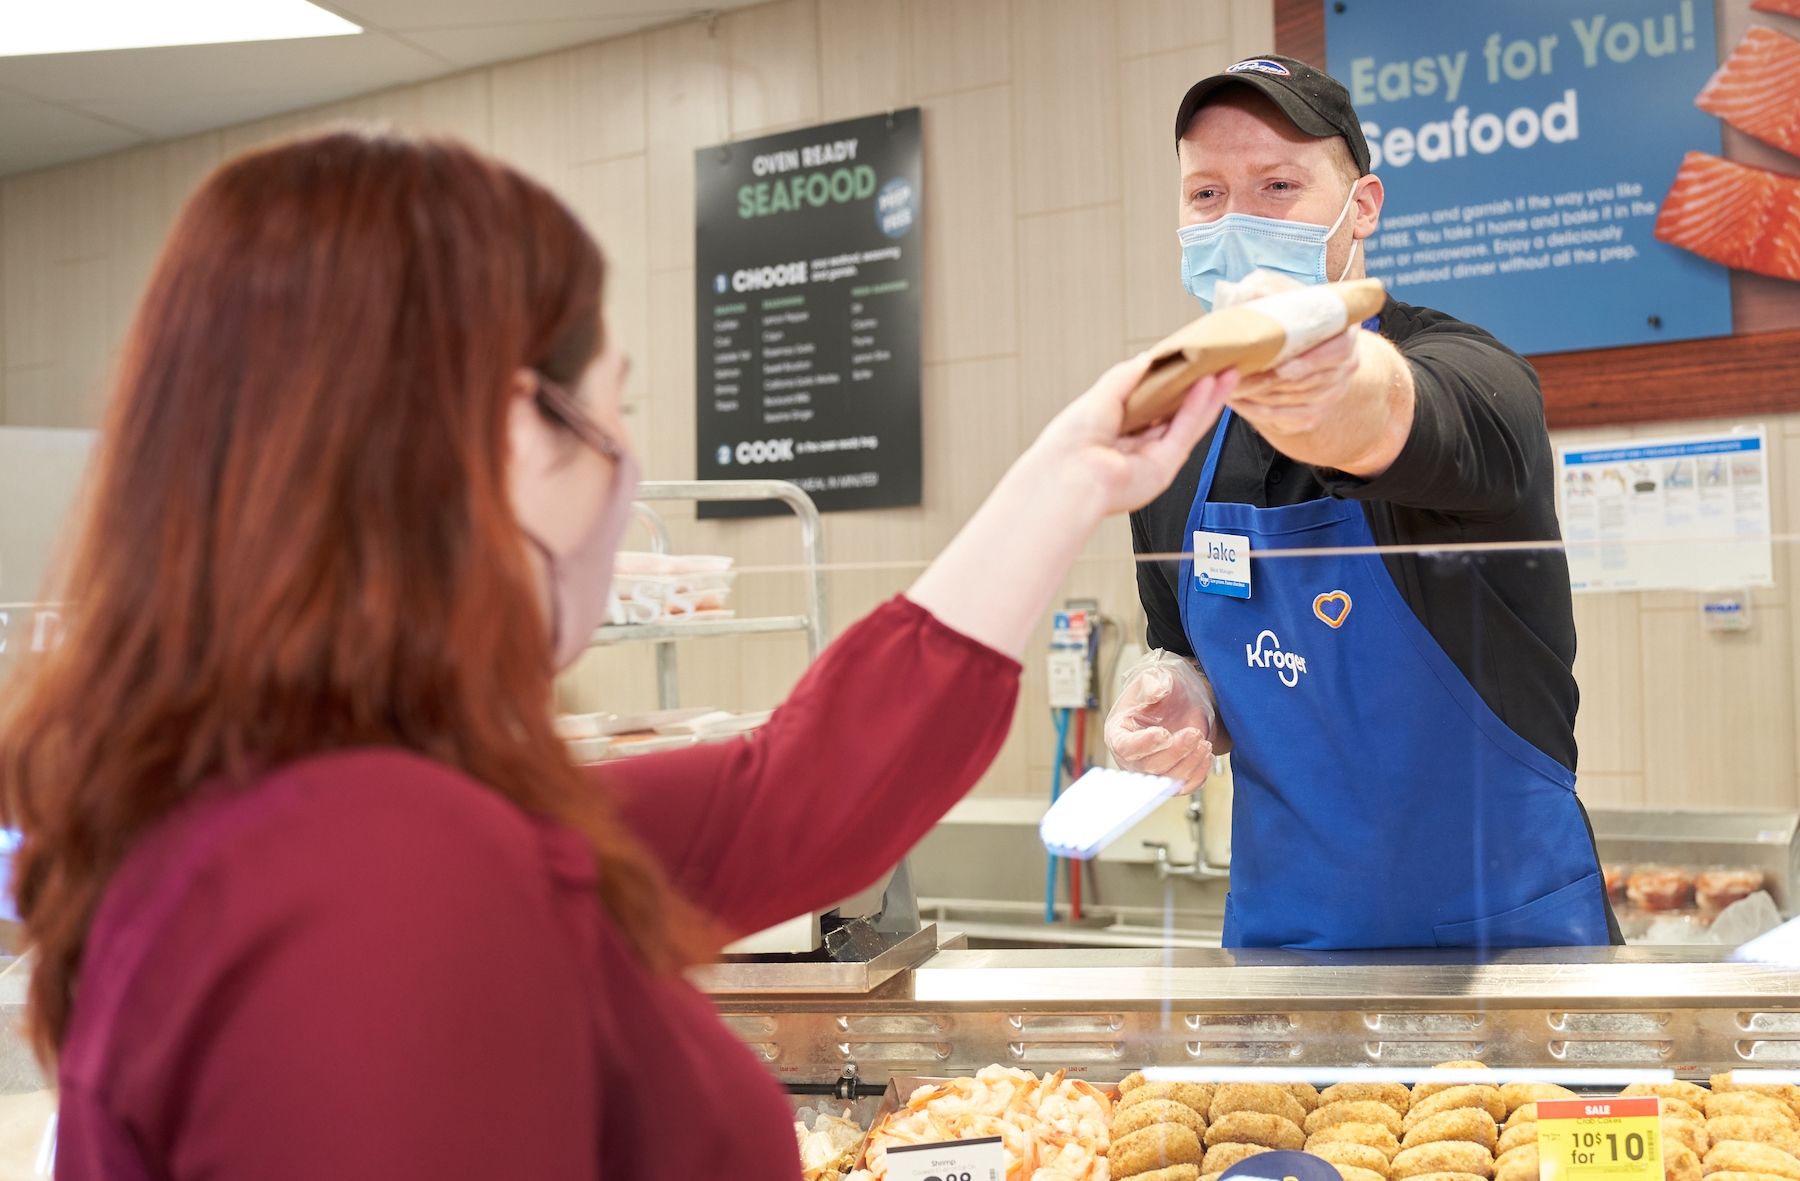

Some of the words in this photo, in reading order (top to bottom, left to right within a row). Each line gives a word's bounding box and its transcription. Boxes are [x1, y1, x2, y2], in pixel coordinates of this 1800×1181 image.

[1351, 52, 1467, 106] Easy
[1484, 34, 1558, 83] for
[1572, 0, 1695, 68] You!
[1360, 90, 1579, 171] Seafood
[752, 149, 800, 176] OVEN
[801, 138, 858, 168] READY
[737, 164, 877, 219] SEAFOOD
[1382, 212, 1430, 230] season
[1431, 206, 1460, 224] and
[1462, 198, 1514, 223] garnish
[1516, 196, 1525, 212] it
[1528, 194, 1551, 210] the
[1553, 191, 1584, 207] way
[1586, 187, 1614, 205] you
[1616, 182, 1643, 198] like
[1380, 231, 1414, 249] FREE.
[1416, 229, 1441, 244] You
[1443, 224, 1474, 241] take
[1475, 221, 1485, 237] it
[1487, 218, 1528, 236] home
[1530, 211, 1560, 230] and
[1562, 207, 1599, 226] bake
[1601, 204, 1612, 220] it
[1614, 203, 1629, 219] in
[1631, 200, 1656, 216] the
[1396, 253, 1411, 267] or
[1493, 237, 1531, 255] Enjoy
[1533, 235, 1545, 249] a
[1546, 224, 1623, 248] deliciously
[1396, 265, 1450, 286] seafood
[1452, 261, 1496, 279] dinner
[1499, 253, 1550, 273] without
[1552, 249, 1571, 267] all
[1573, 248, 1598, 264] the
[1600, 245, 1639, 264] prep.
[732, 261, 808, 292] CHOOSE
[735, 438, 794, 464] COOK
[1207, 542, 1236, 563] Jake
[1246, 630, 1308, 688] Kroger
[1576, 1117, 1595, 1125] Crab
[1585, 1105, 1611, 1116] SALE
[1571, 1150, 1595, 1164] for
